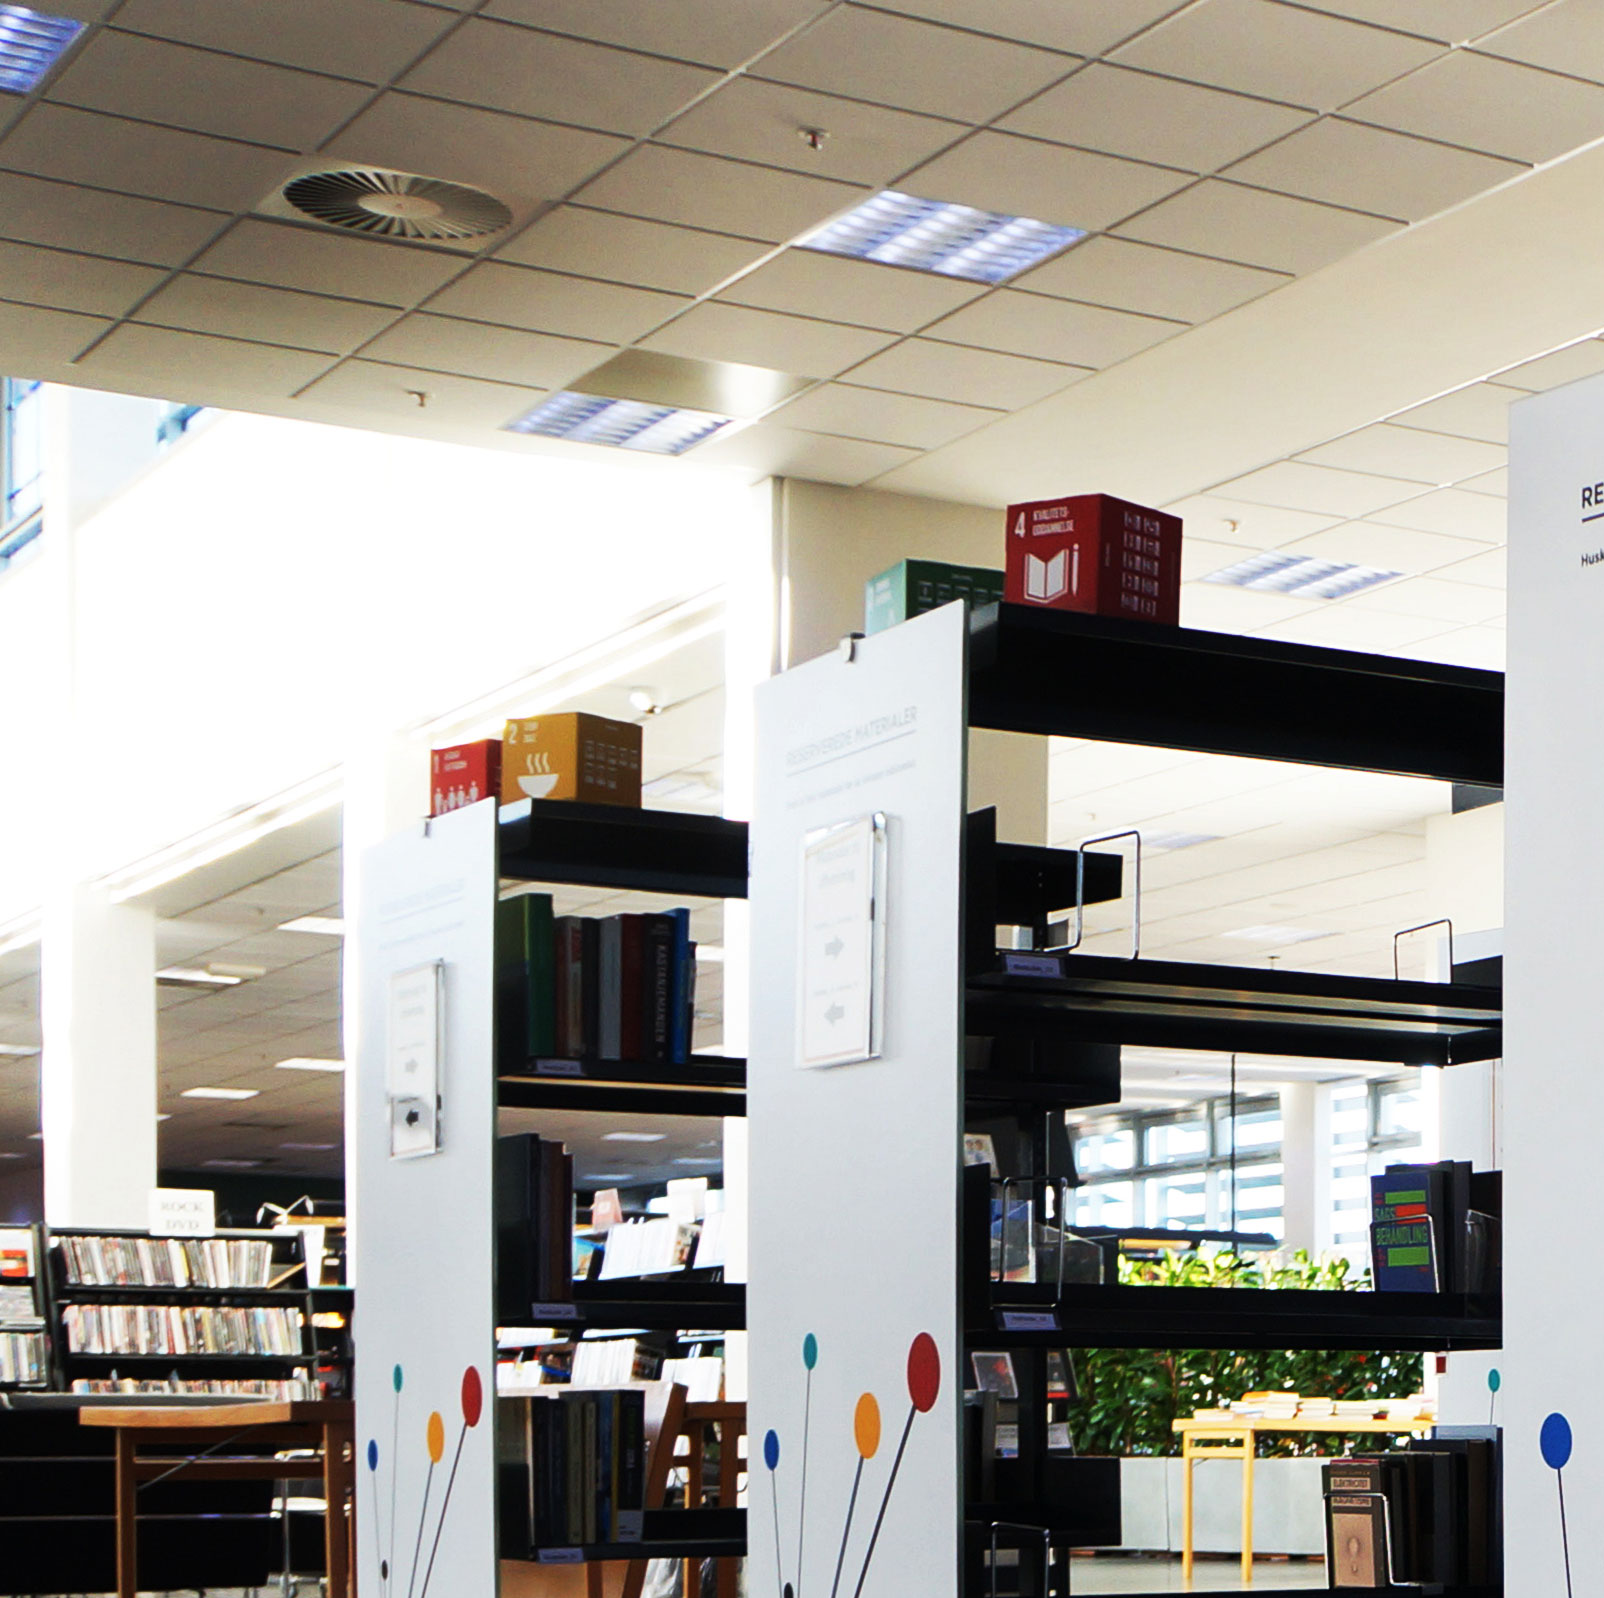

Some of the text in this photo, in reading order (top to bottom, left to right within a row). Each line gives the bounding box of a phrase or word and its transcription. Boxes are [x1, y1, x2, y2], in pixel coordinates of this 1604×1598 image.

[1014, 511, 1026, 538] 4
[1581, 548, 1604, 567] Husk
[508, 723, 518, 744] 2
[166, 1219, 199, 1230] DVD
[1375, 1225, 1428, 1246] BEHANDLING
